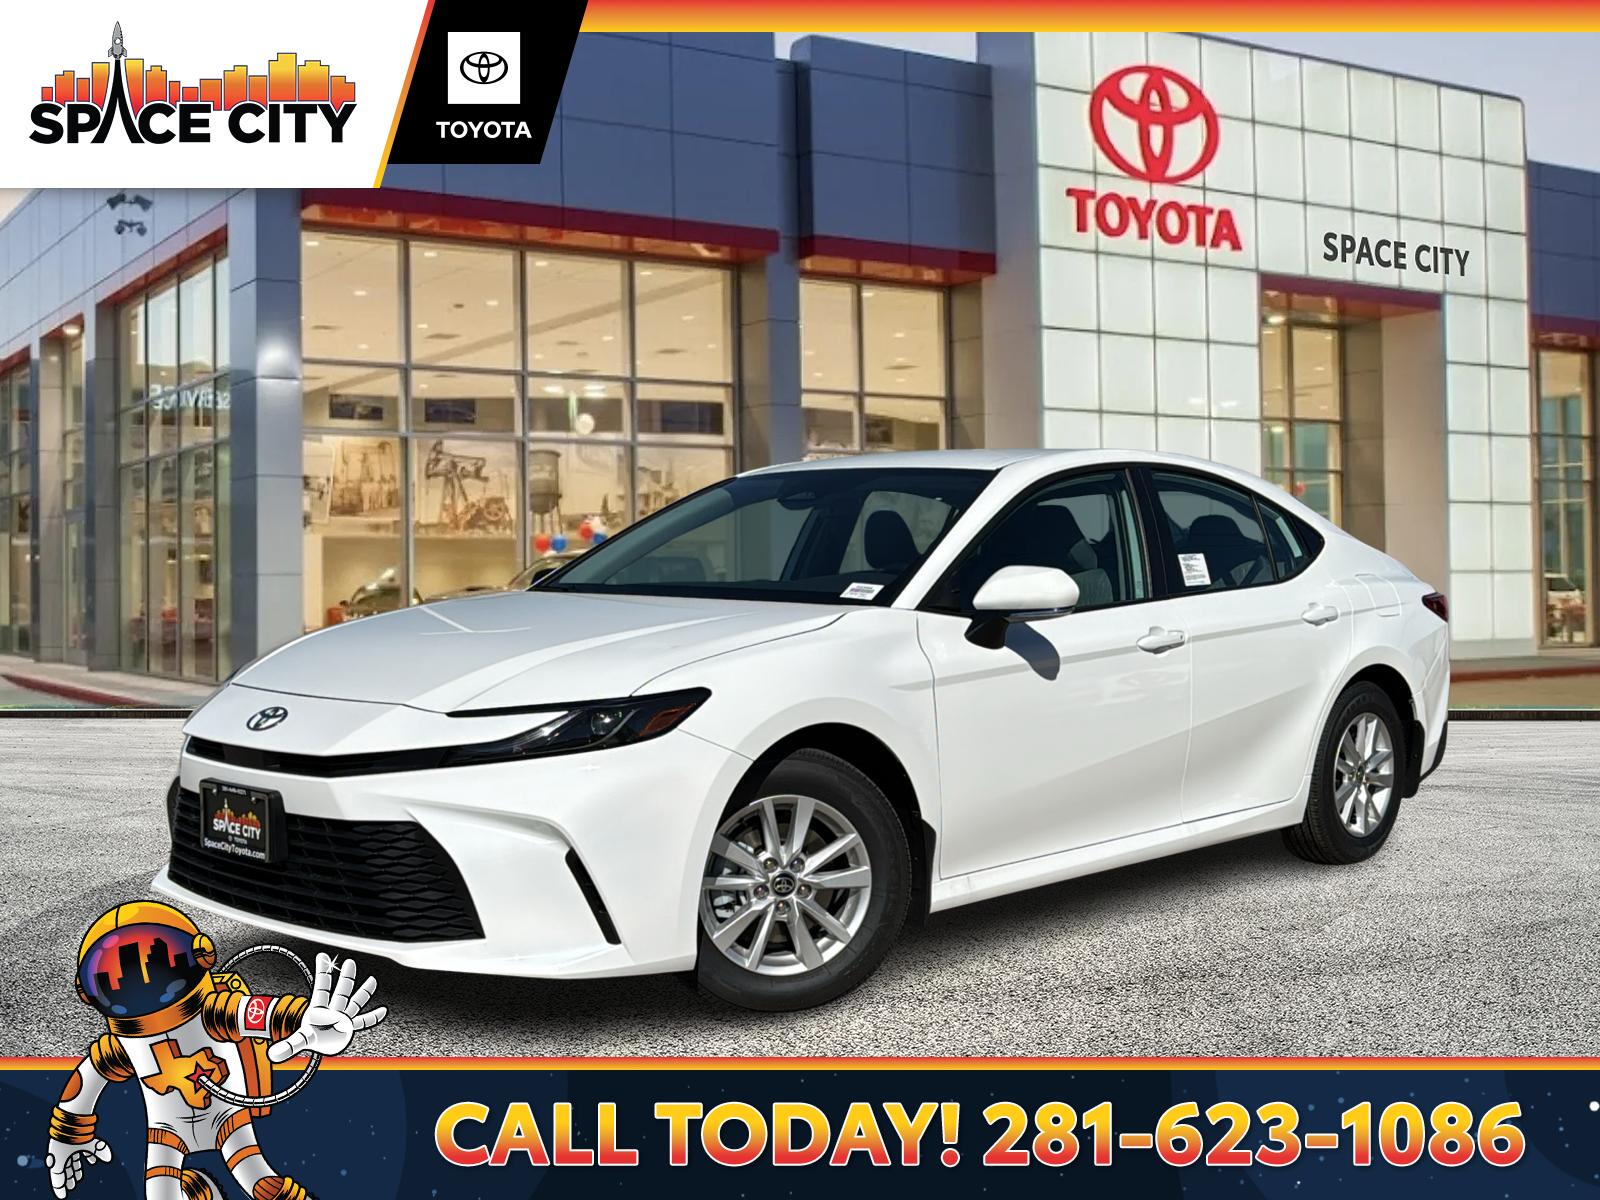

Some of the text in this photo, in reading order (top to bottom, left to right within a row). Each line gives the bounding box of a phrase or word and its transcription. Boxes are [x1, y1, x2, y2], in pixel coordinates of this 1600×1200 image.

[1066, 187, 1243, 252] TOYOTA
[1322, 231, 1471, 277] SPACE CITY
[213, 816, 262, 840] SPACE CITY
[204, 837, 266, 860] SpaceCityToyota.com
